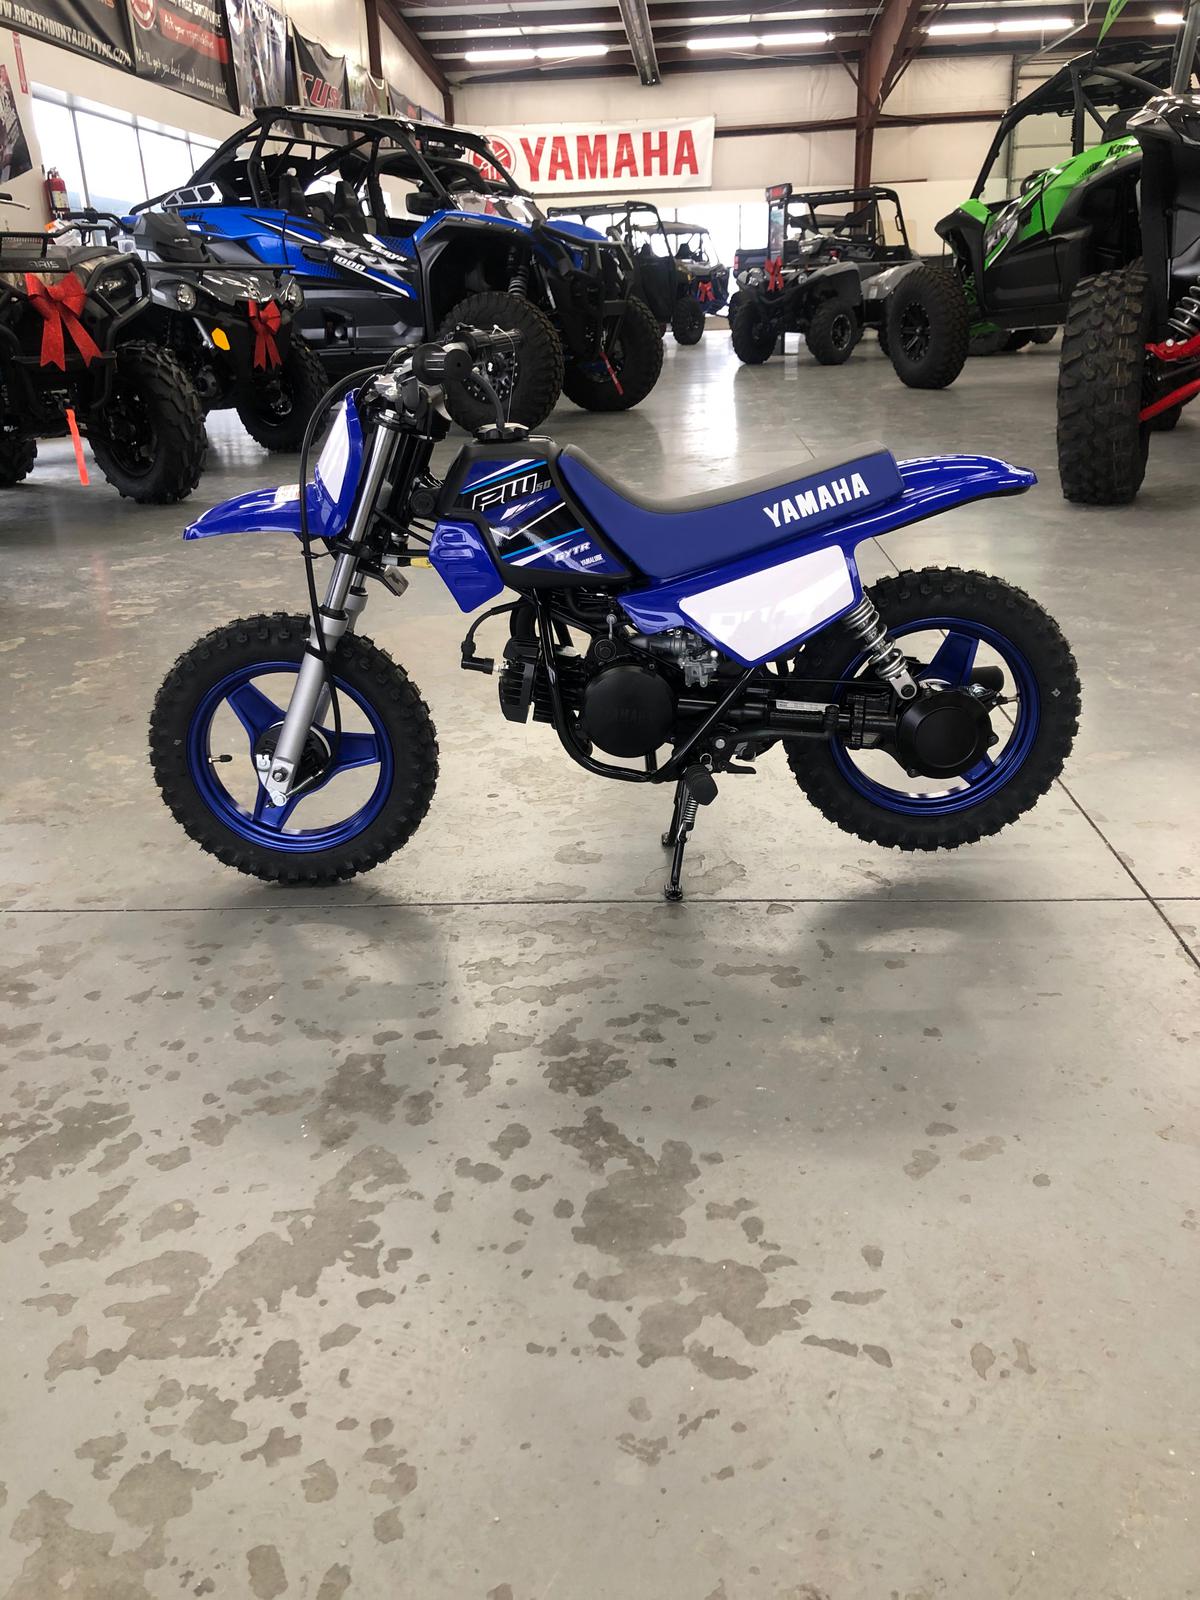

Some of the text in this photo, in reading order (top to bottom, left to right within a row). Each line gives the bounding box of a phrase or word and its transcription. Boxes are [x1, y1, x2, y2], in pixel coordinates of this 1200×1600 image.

[519, 129, 699, 182] YAMAHA
[332, 254, 367, 272] 1000
[535, 479, 552, 493] 50
[762, 472, 871, 528] YAMAHA
[553, 541, 592, 563] GYTR
